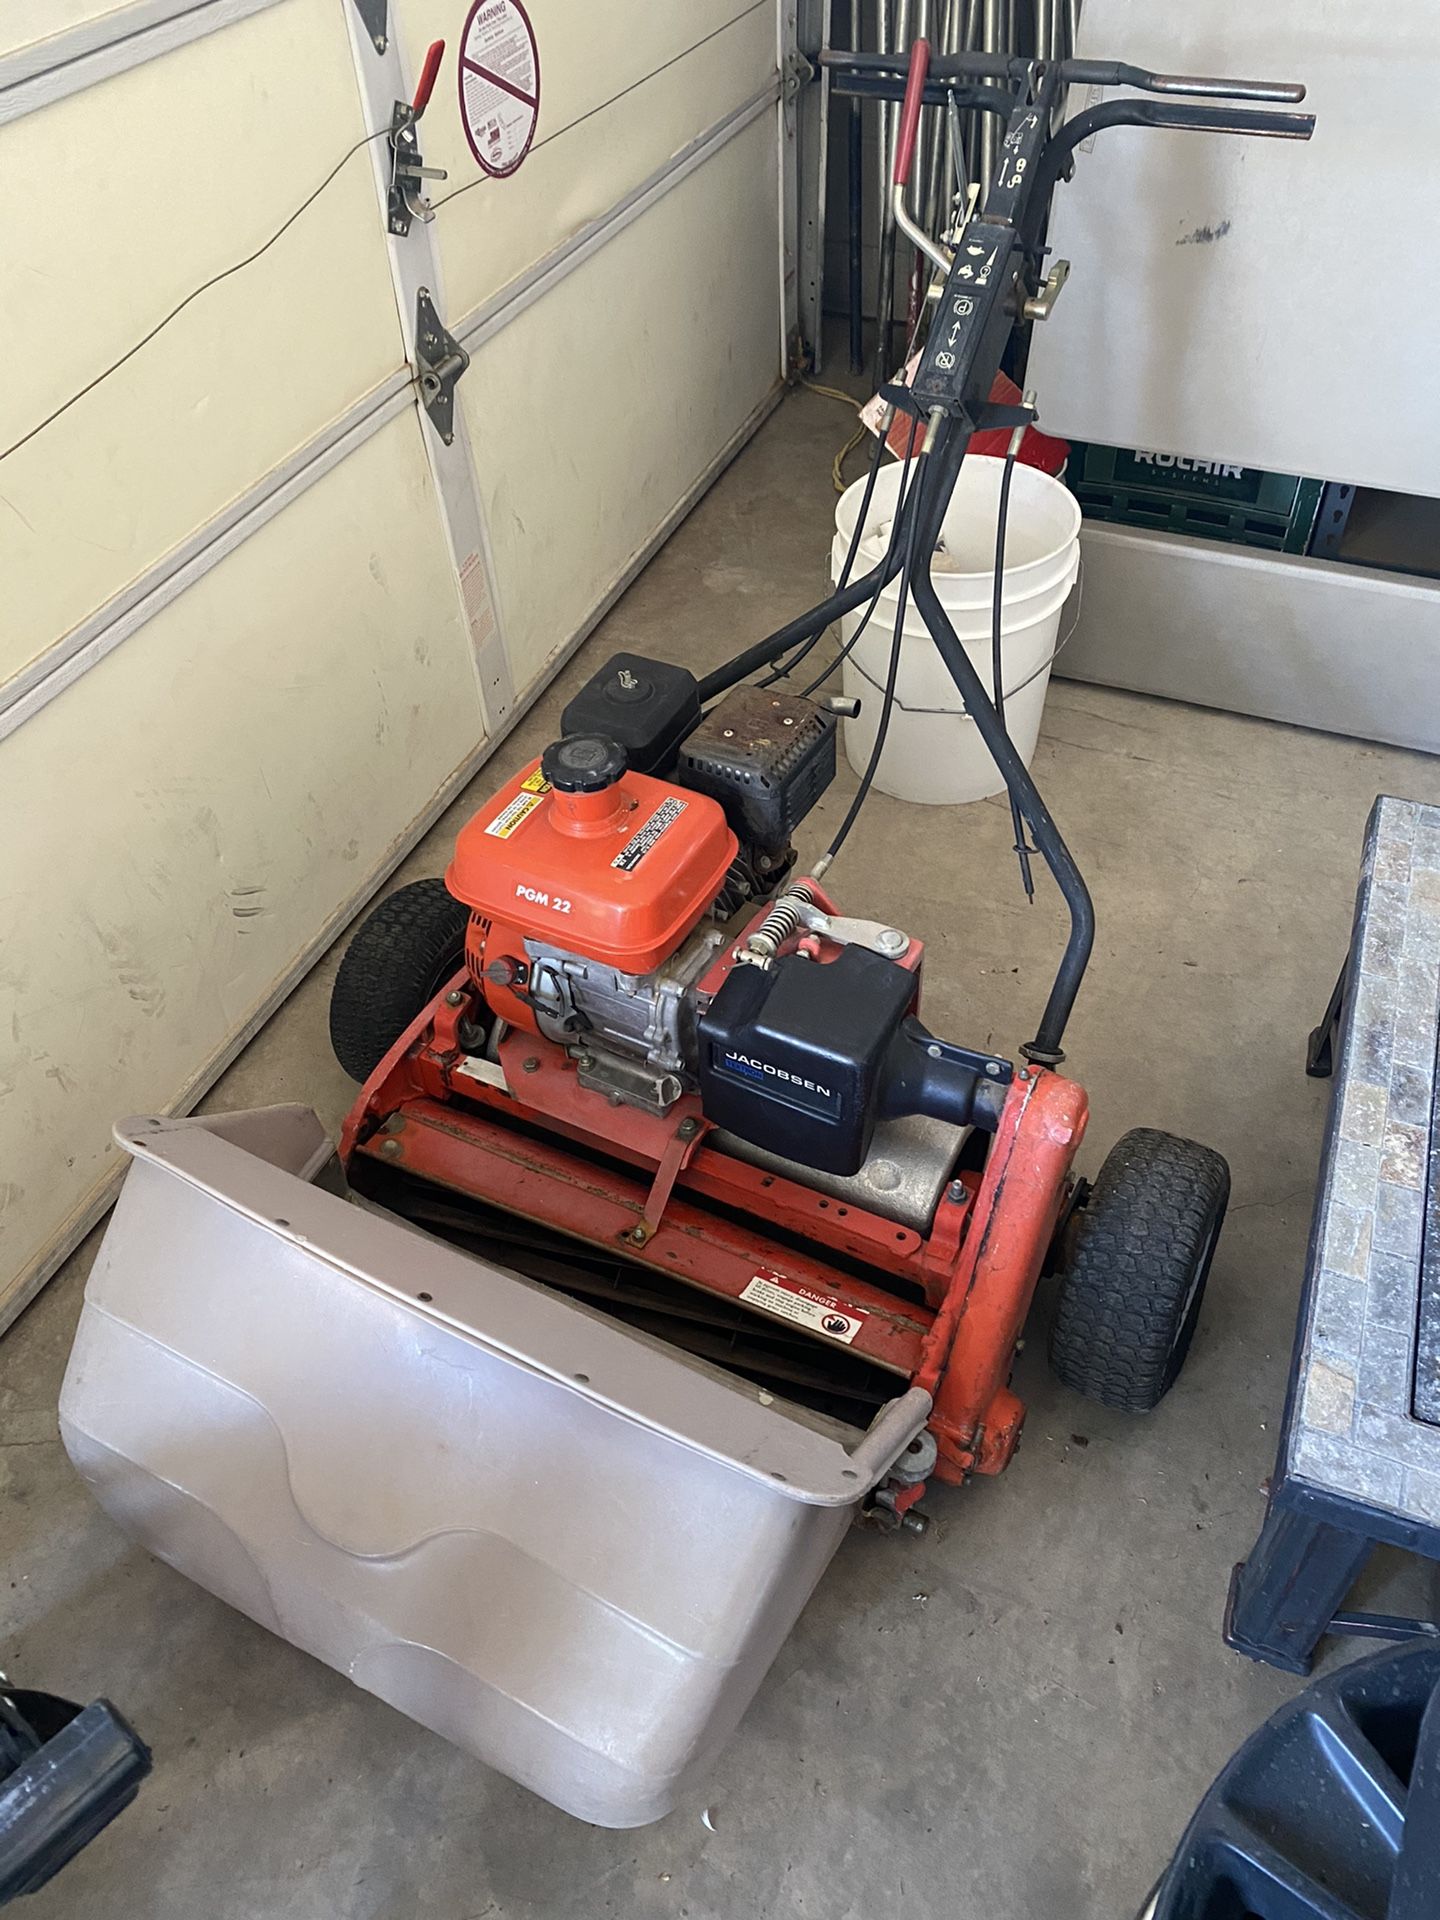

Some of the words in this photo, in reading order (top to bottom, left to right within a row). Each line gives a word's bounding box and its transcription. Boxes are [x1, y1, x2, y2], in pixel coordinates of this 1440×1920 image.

[477, 1, 506, 25] WARNING
[506, 801, 535, 831] CAUTION
[515, 884, 549, 906] PGM
[551, 898, 571, 914] 22
[725, 1051, 831, 1097] JACOBSEN
[798, 1288, 837, 1309] DANGER
